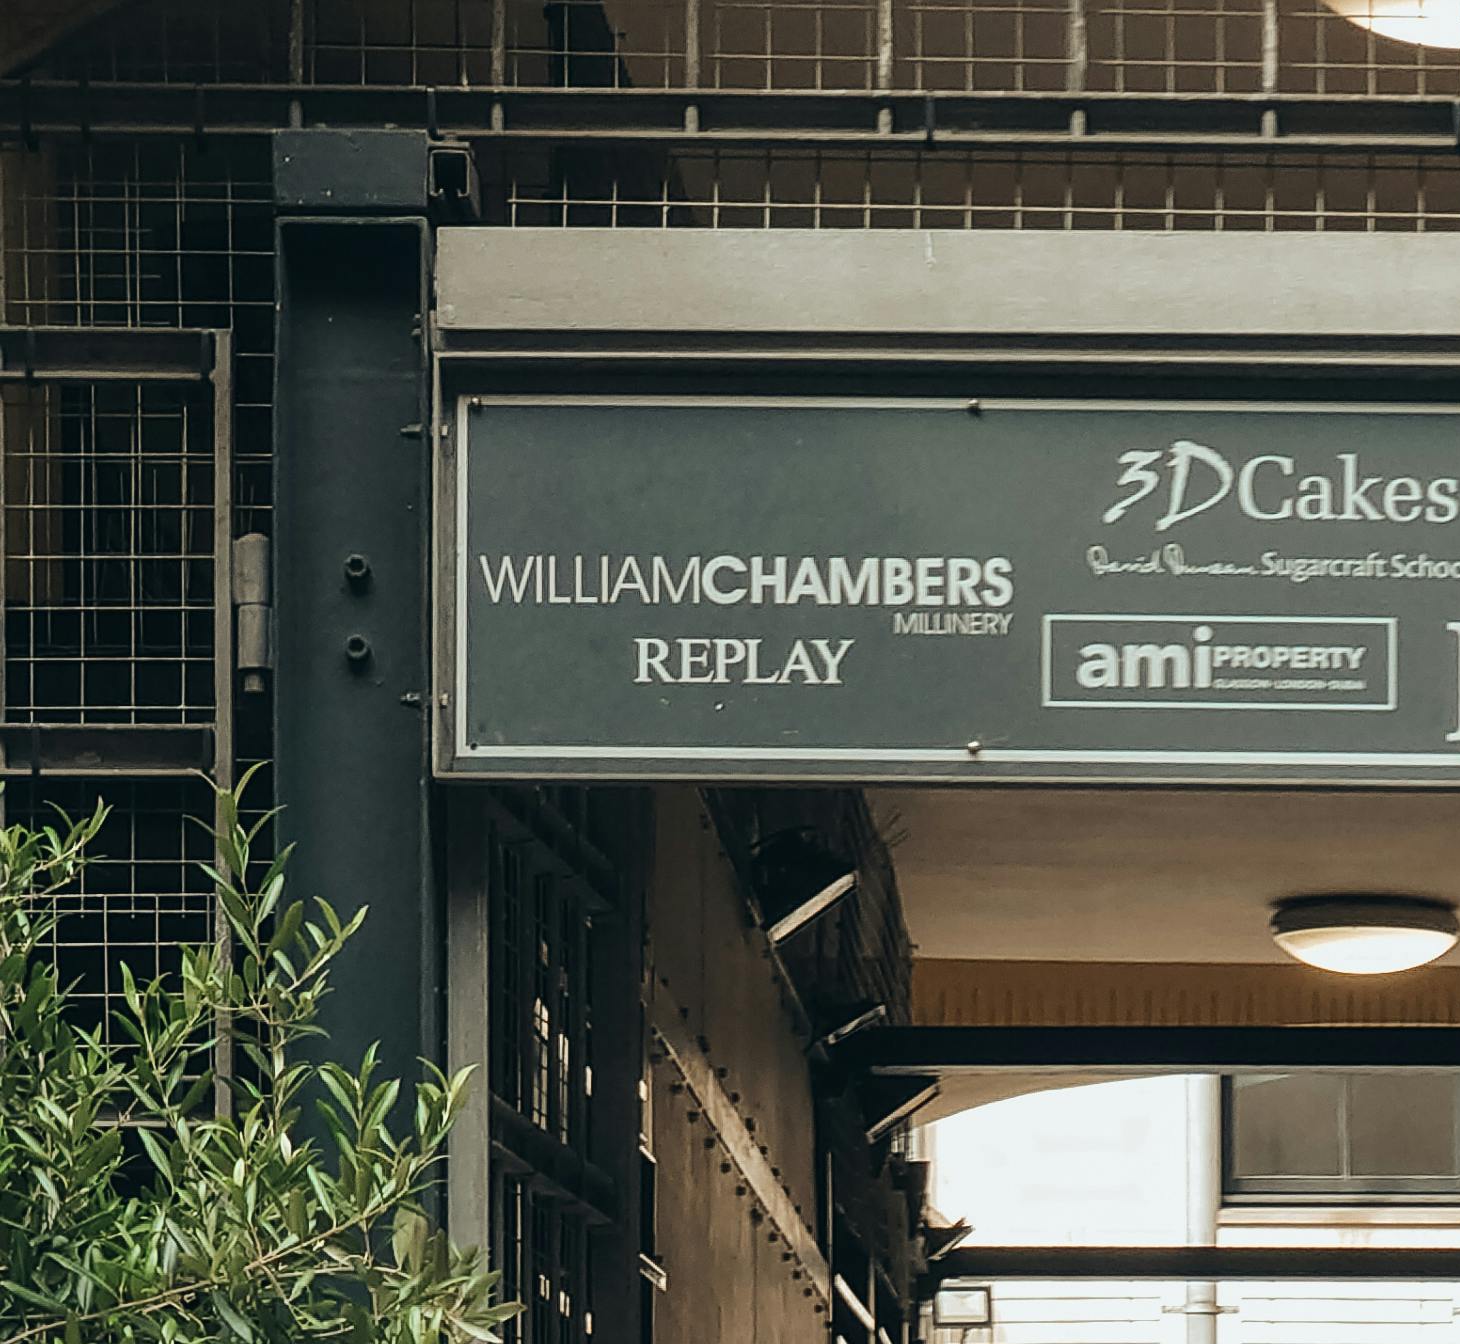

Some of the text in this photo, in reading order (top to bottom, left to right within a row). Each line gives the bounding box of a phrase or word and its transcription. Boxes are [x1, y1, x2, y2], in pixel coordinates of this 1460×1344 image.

[1238, 453, 1460, 523] Cakes
[1261, 551, 1388, 583] Sugarcraft
[894, 612, 1014, 635] MILLINERY
[633, 638, 855, 684] REPLAY
[1213, 646, 1367, 669] PROPERTY
